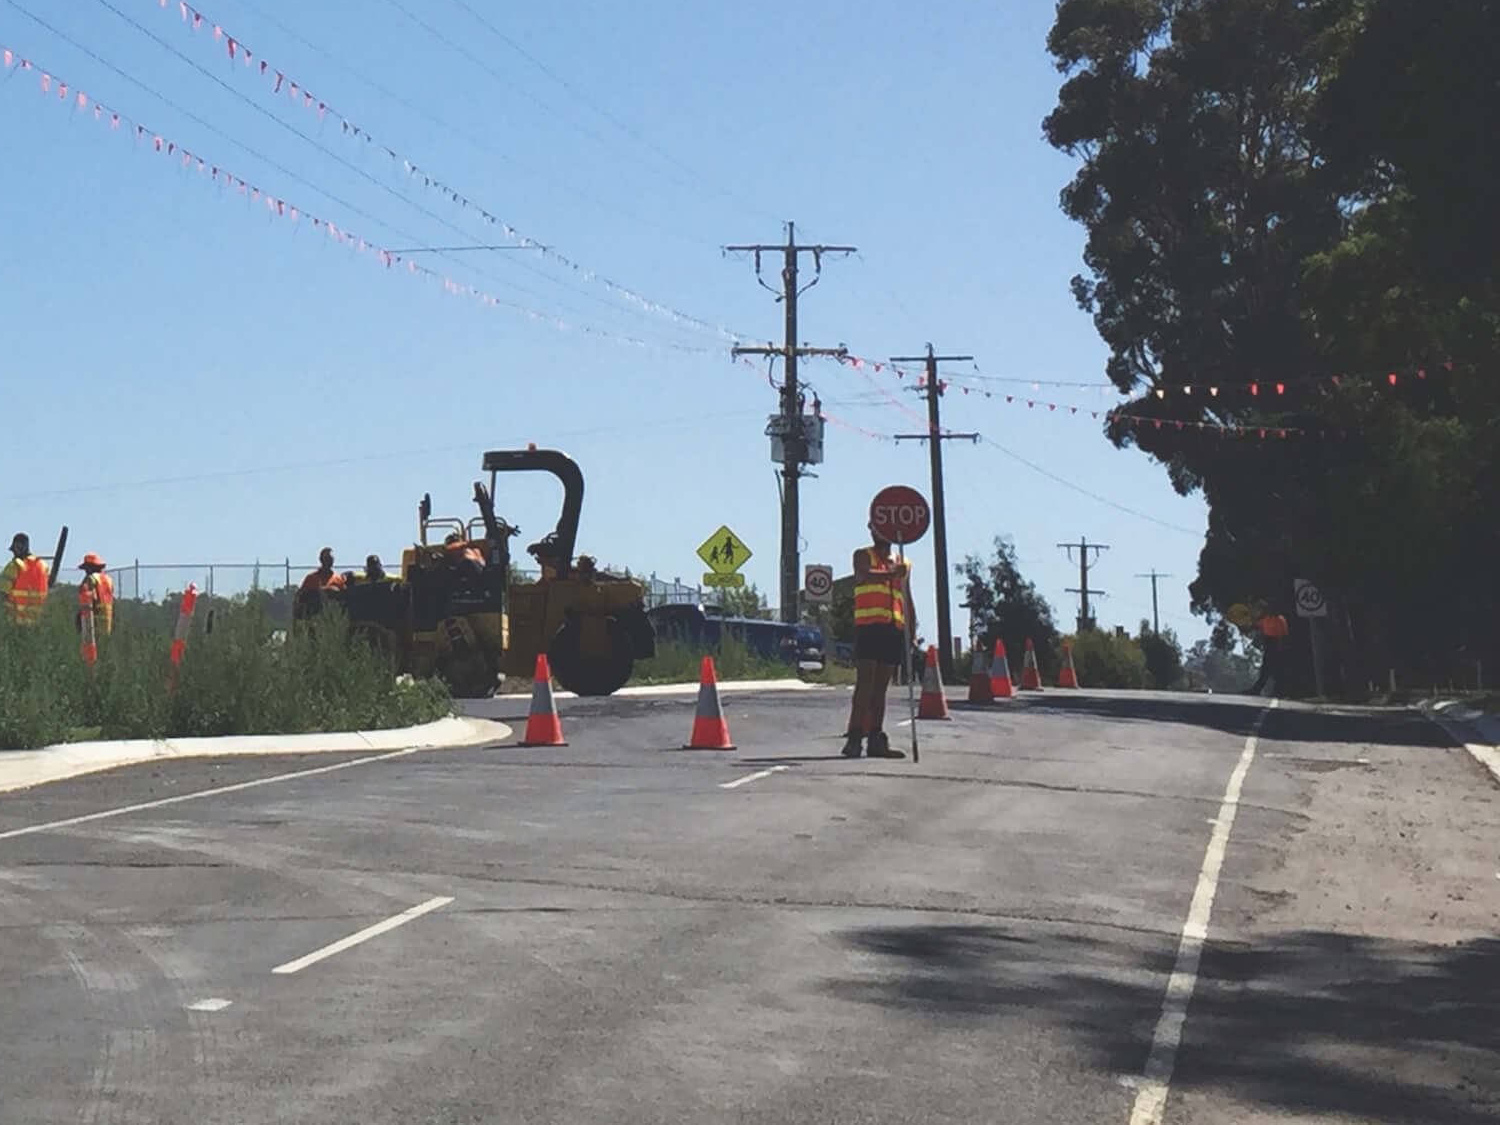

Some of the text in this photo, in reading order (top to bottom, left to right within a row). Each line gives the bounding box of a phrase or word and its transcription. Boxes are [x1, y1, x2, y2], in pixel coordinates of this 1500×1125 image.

[875, 505, 926, 524] STOP
[811, 576, 827, 589] 40
[1301, 590, 1318, 603] 40
